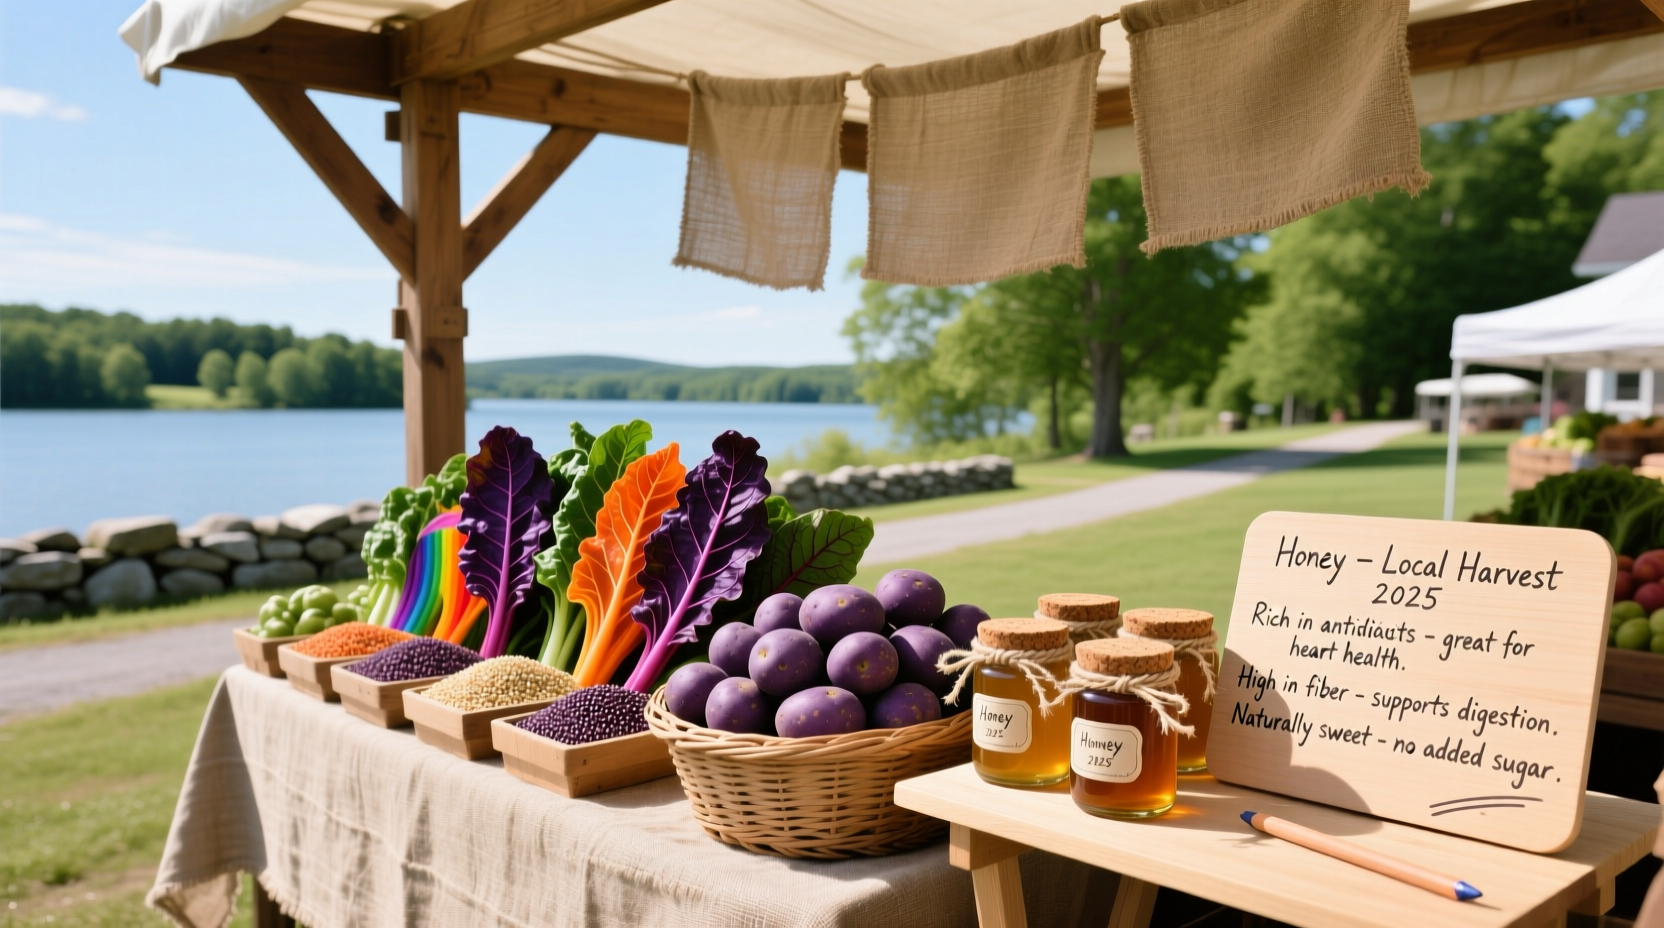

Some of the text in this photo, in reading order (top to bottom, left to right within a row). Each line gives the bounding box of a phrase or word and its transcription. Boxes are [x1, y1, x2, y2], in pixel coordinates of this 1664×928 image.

[1275, 534, 1347, 586] Honey
[1381, 543, 1449, 579] Local
[1456, 550, 1564, 591] Harvest
[1371, 582, 1444, 611] 2025
[1251, 600, 1290, 629] Rich
[1297, 611, 1313, 631] in
[1438, 630, 1498, 662] great
[1502, 629, 1536, 660] for
[1289, 634, 1406, 672] heart health.
[979, 704, 1013, 730] Honey
[1237, 663, 1276, 700] High
[1282, 676, 1298, 694] in
[1305, 673, 1350, 702] fiber
[1370, 694, 1450, 723] supports
[1457, 696, 1558, 737] digestion.
[1231, 701, 1314, 747] Naturally
[1318, 723, 1374, 747] sweet
[1392, 737, 1417, 755] no
[1422, 736, 1487, 768] added
[1491, 753, 1561, 790] sugar.
